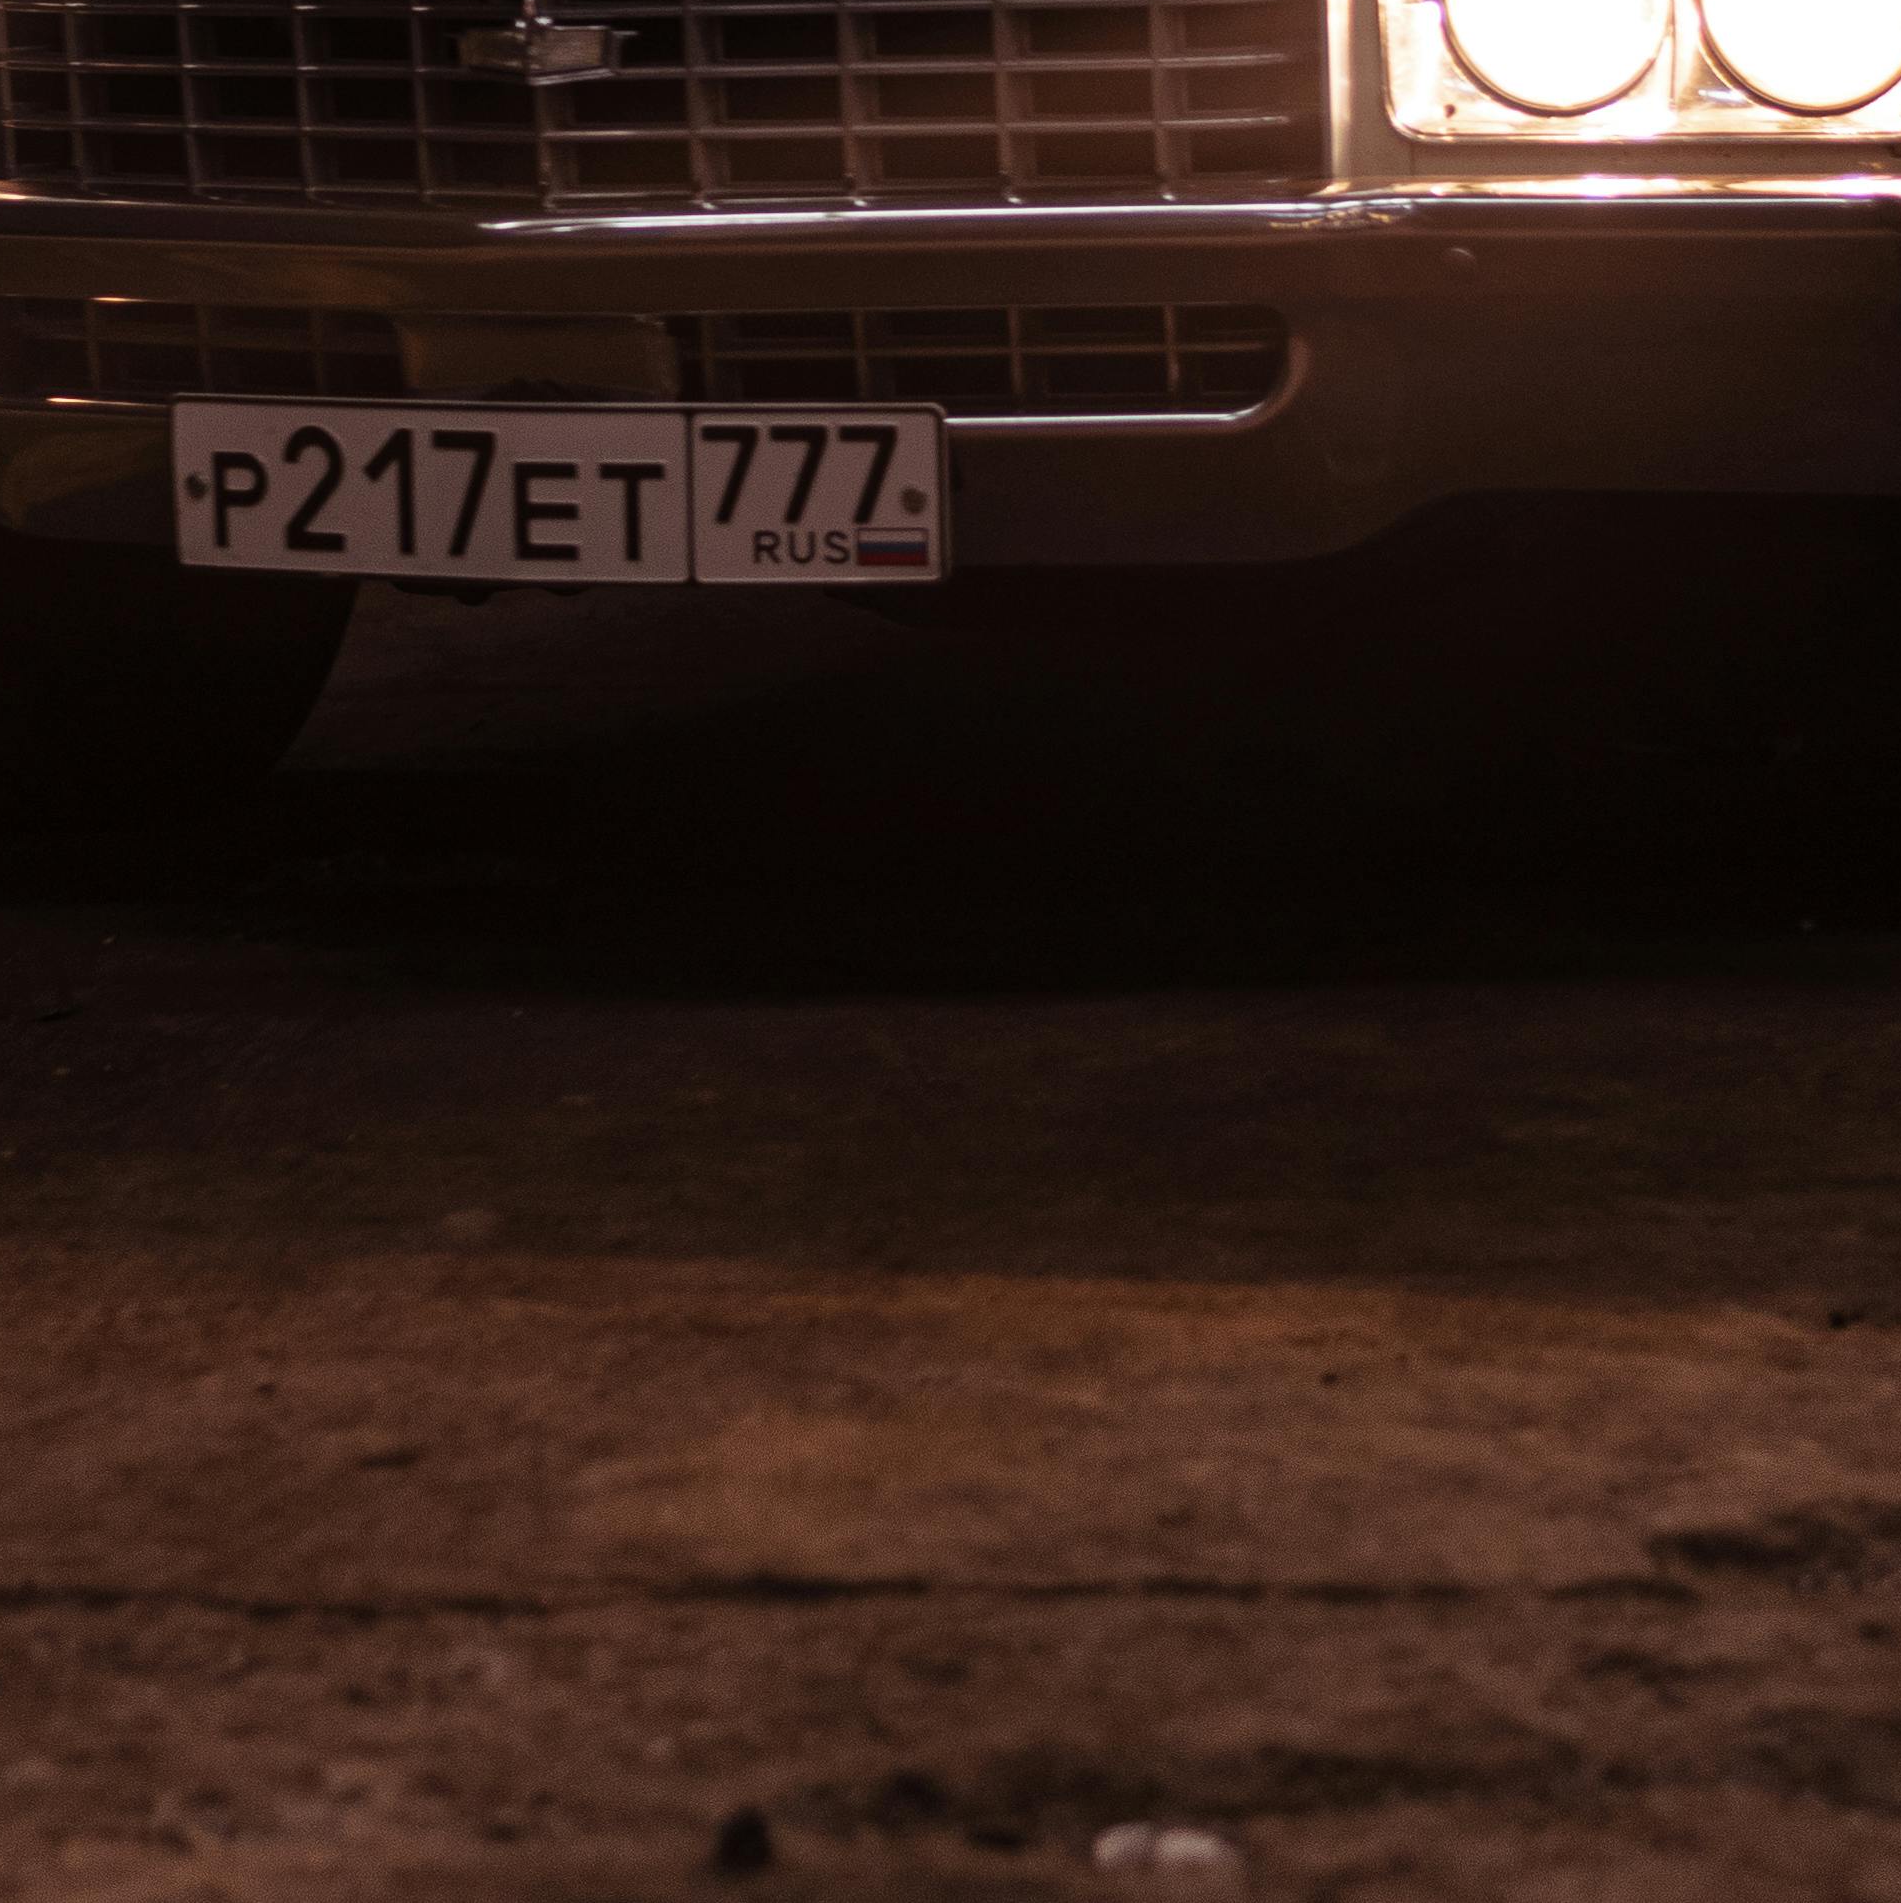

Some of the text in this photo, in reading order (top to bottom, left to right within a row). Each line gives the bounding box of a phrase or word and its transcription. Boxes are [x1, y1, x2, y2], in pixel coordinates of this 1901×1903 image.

[211, 425, 898, 563] P217ET 777
[753, 530, 851, 565] RUS
